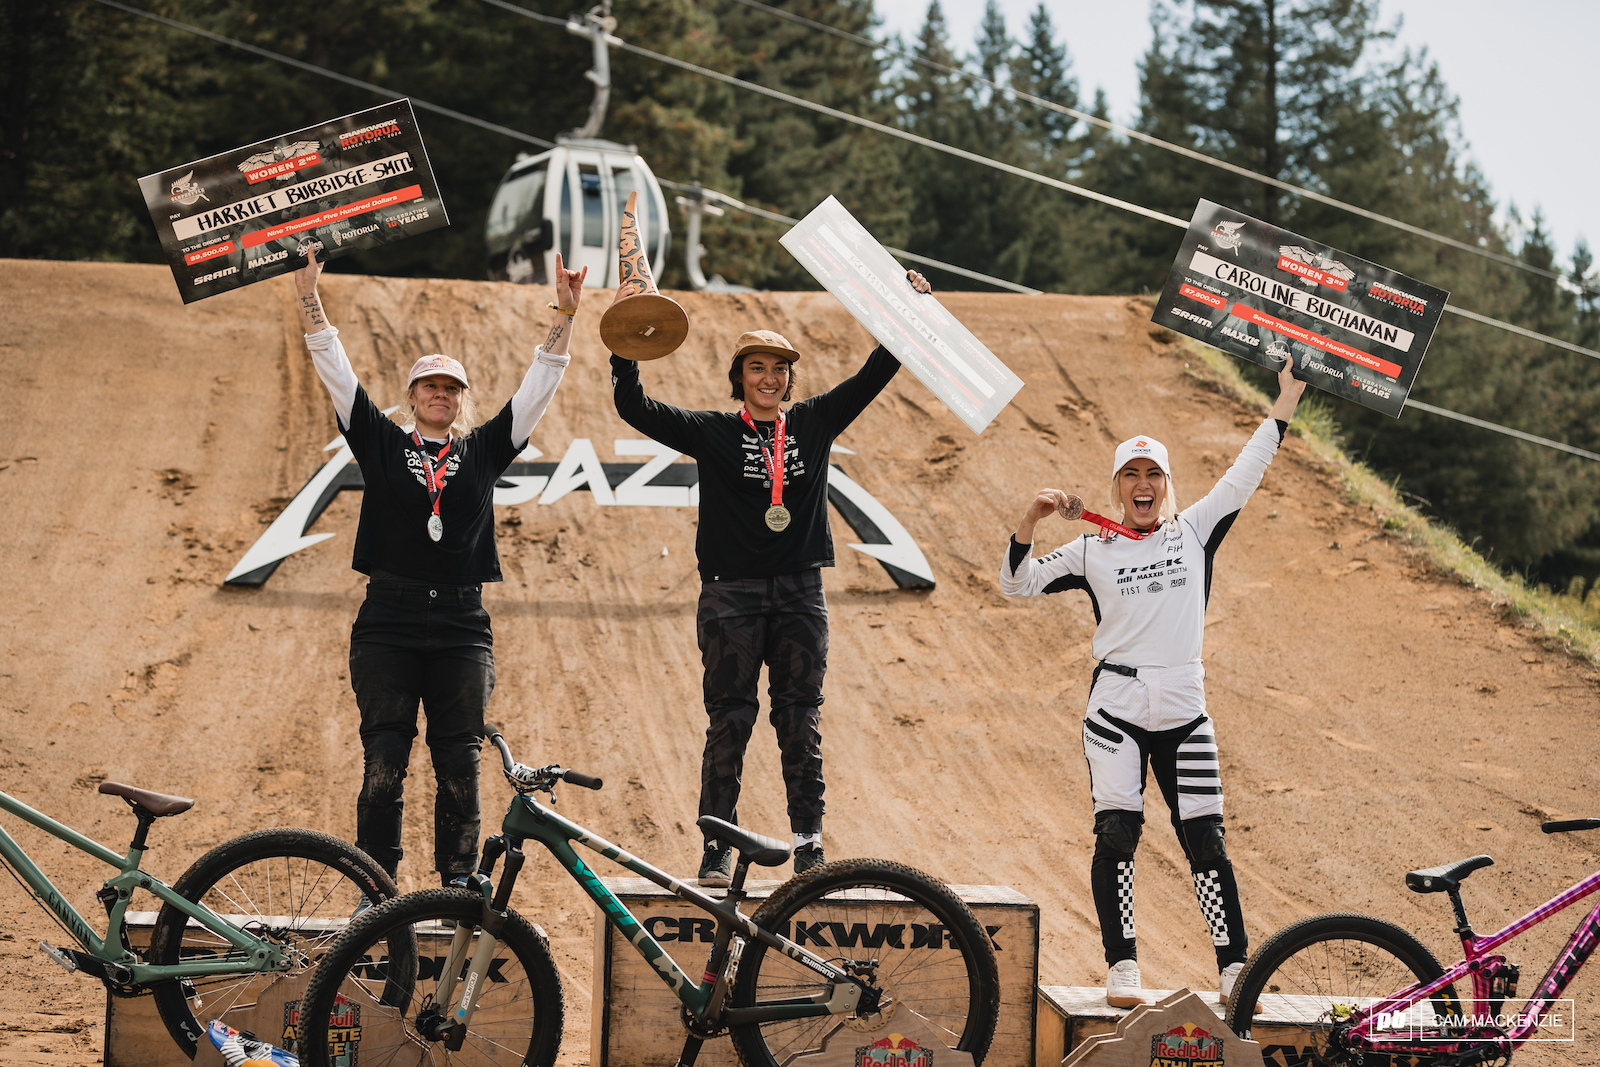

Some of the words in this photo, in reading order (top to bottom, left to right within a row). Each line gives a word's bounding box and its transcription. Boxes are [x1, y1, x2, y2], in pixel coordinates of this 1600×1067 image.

[338, 118, 397, 140] CRANKWORX
[340, 123, 400, 147] ROTORUA
[248, 161, 294, 180] WOMEN
[195, 192, 280, 231] HARRIET
[266, 227, 283, 237] Nine
[322, 211, 338, 220] Five
[338, 201, 370, 216] Hundred
[371, 193, 397, 206] Dollars
[385, 206, 427, 222] CELEBRATING
[387, 220, 397, 228] 10
[398, 210, 429, 225] YEARS
[341, 223, 379, 240] ROTORUA
[246, 250, 288, 269] MAXXIS
[1280, 259, 1322, 280] WOMEN
[1325, 276, 1344, 288] 3RD
[1213, 261, 1303, 308] CAROLINE
[1303, 296, 1399, 345] BUCHANAN
[1369, 285, 1425, 312] ROTORUA
[1220, 325, 1260, 346] MAXXIS
[1252, 313, 1274, 325] Seven
[1310, 335, 1324, 345] Five
[1325, 341, 1355, 357] Hundred
[1355, 353, 1380, 367] Dollars
[908, 353, 938, 382] ROTORUA
[1308, 360, 1345, 379] ROTORUA
[1350, 378, 1360, 387] 10
[1360, 382, 1390, 399] YEARS
[1352, 374, 1391, 393] CELEBRATING
[1114, 556, 1184, 576] TREK
[1136, 571, 1164, 580] MAXXIS
[1120, 586, 1140, 596] FIST
[572, 858, 636, 926] YETI
[50, 892, 92, 947] CANYON
[802, 956, 836, 980] SHIMANO
[863, 1056, 893, 1067] Red
[1158, 1042, 1187, 1058] Red
[1188, 1044, 1217, 1060] Bull
